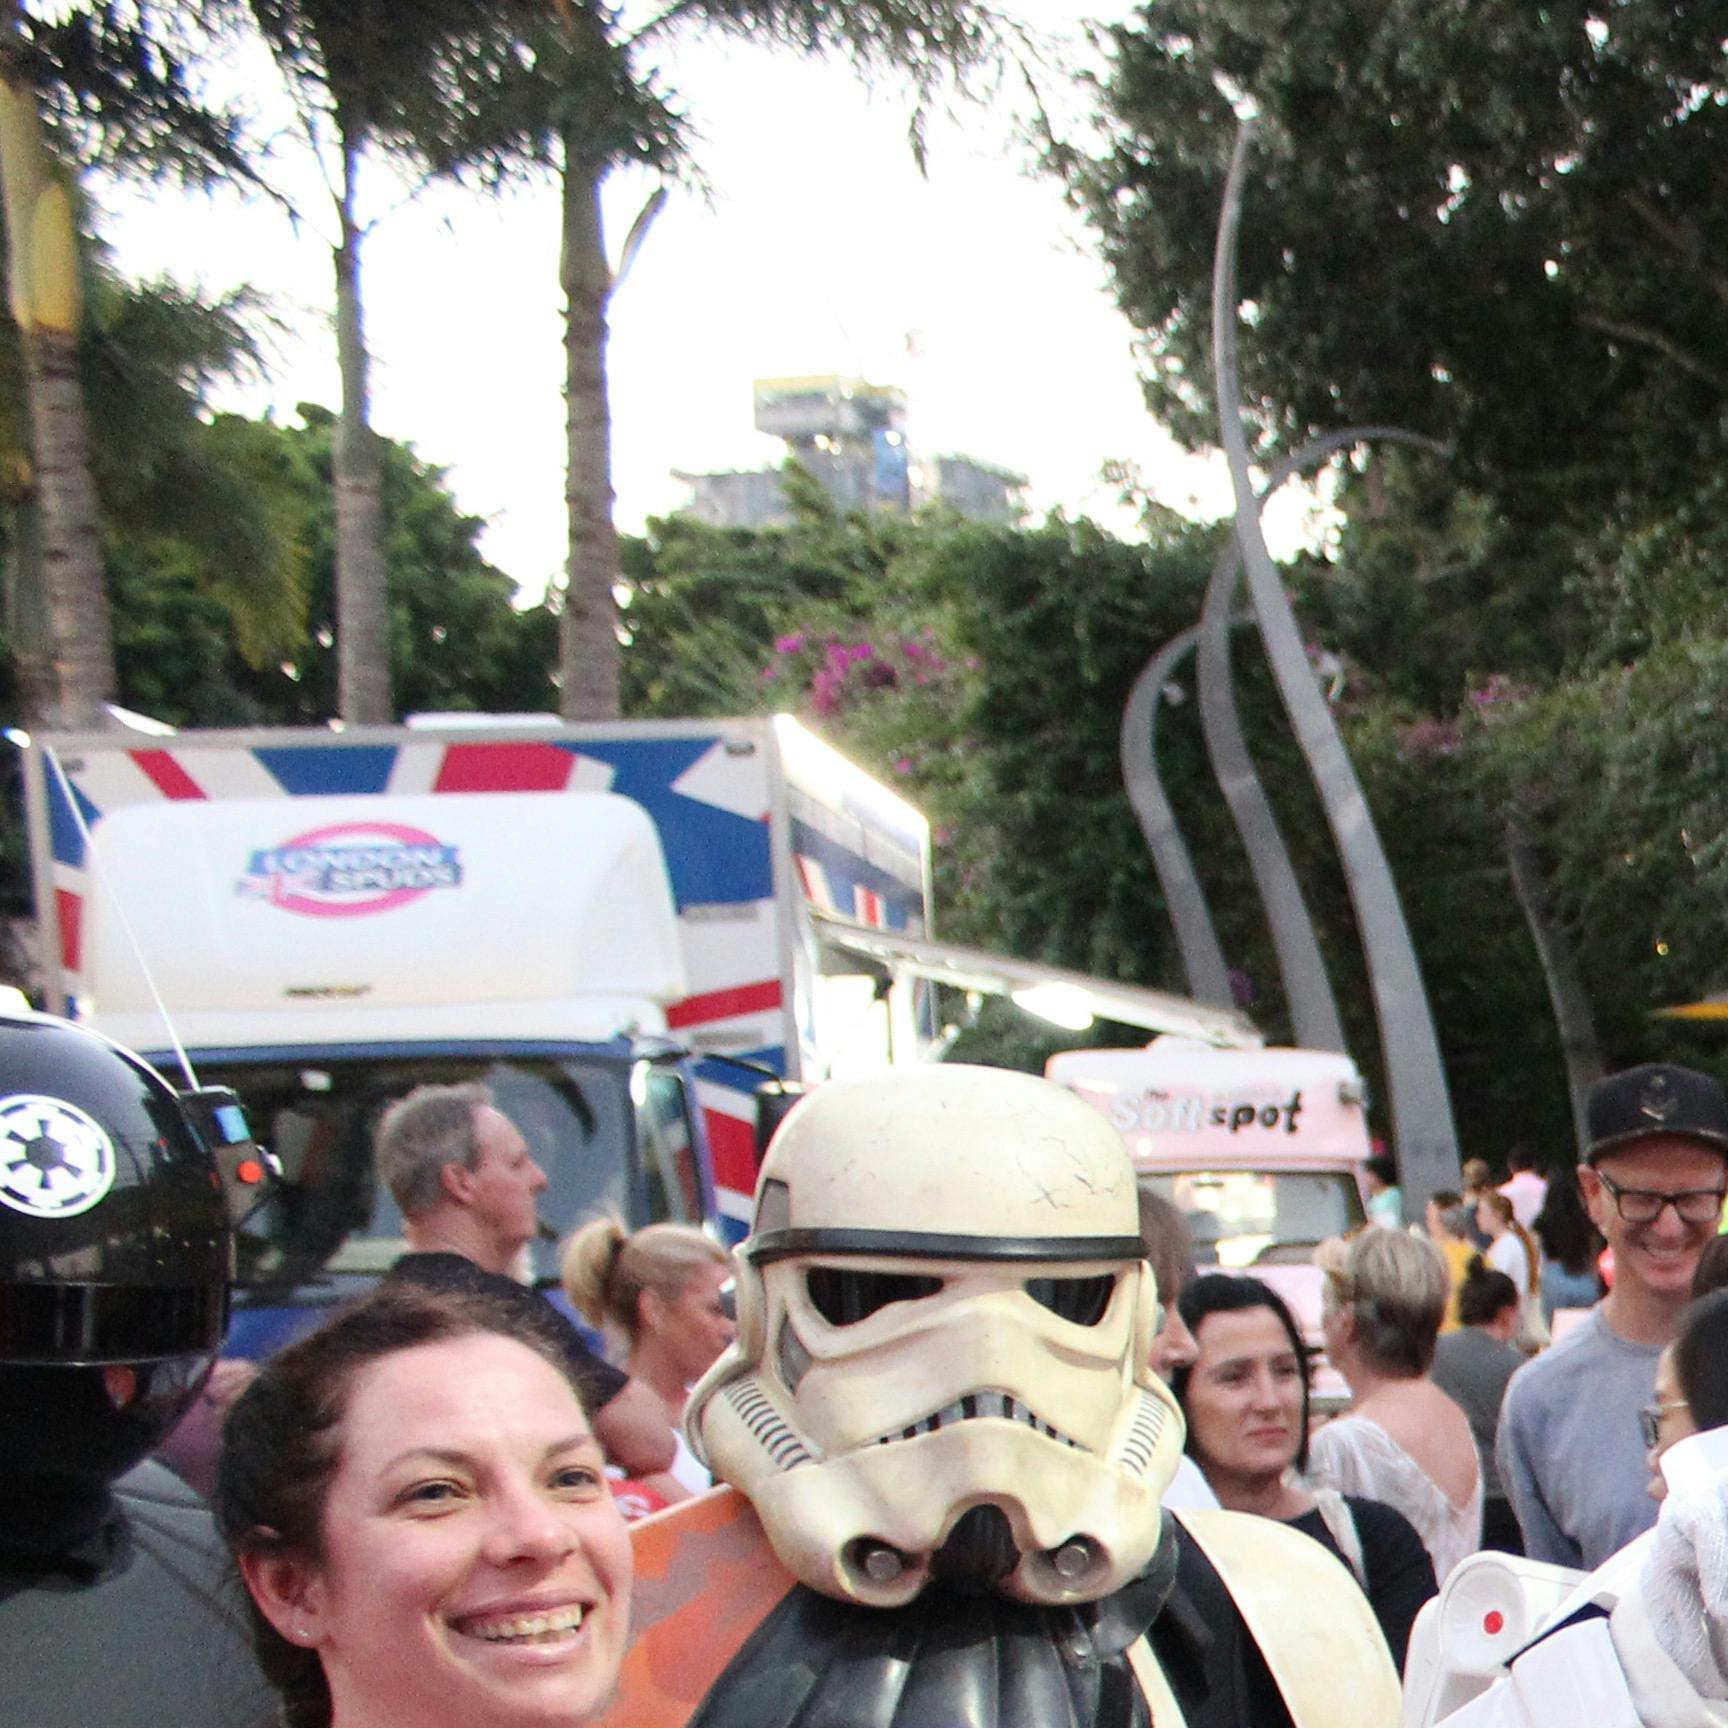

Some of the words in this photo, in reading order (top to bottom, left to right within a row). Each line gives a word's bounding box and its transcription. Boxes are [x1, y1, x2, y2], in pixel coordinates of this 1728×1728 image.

[264, 848, 441, 872] LONDON
[331, 867, 455, 889] SPUDS
[1209, 1090, 1304, 1135] spot
